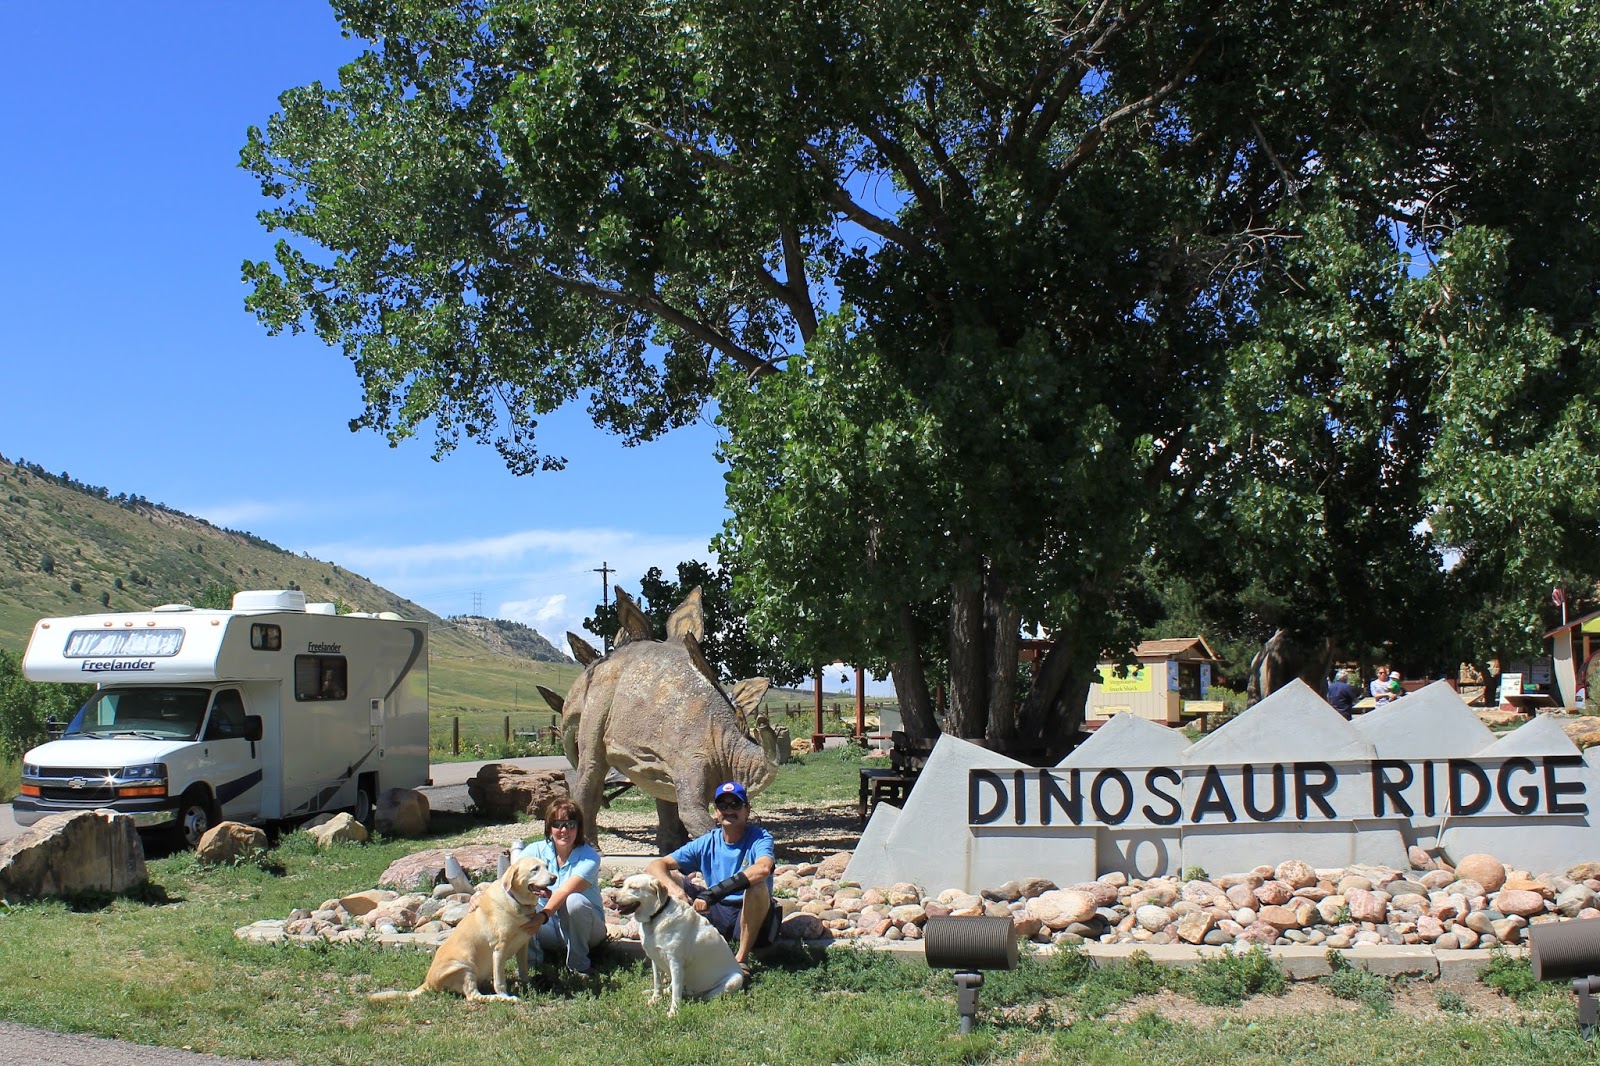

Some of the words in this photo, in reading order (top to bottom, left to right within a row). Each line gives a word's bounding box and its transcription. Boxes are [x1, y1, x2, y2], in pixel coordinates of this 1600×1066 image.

[308, 641, 341, 653] Freelander
[81, 659, 155, 671] Freelander
[968, 762, 1337, 825] DINOSAUR
[1371, 756, 1588, 817] RIDGE
